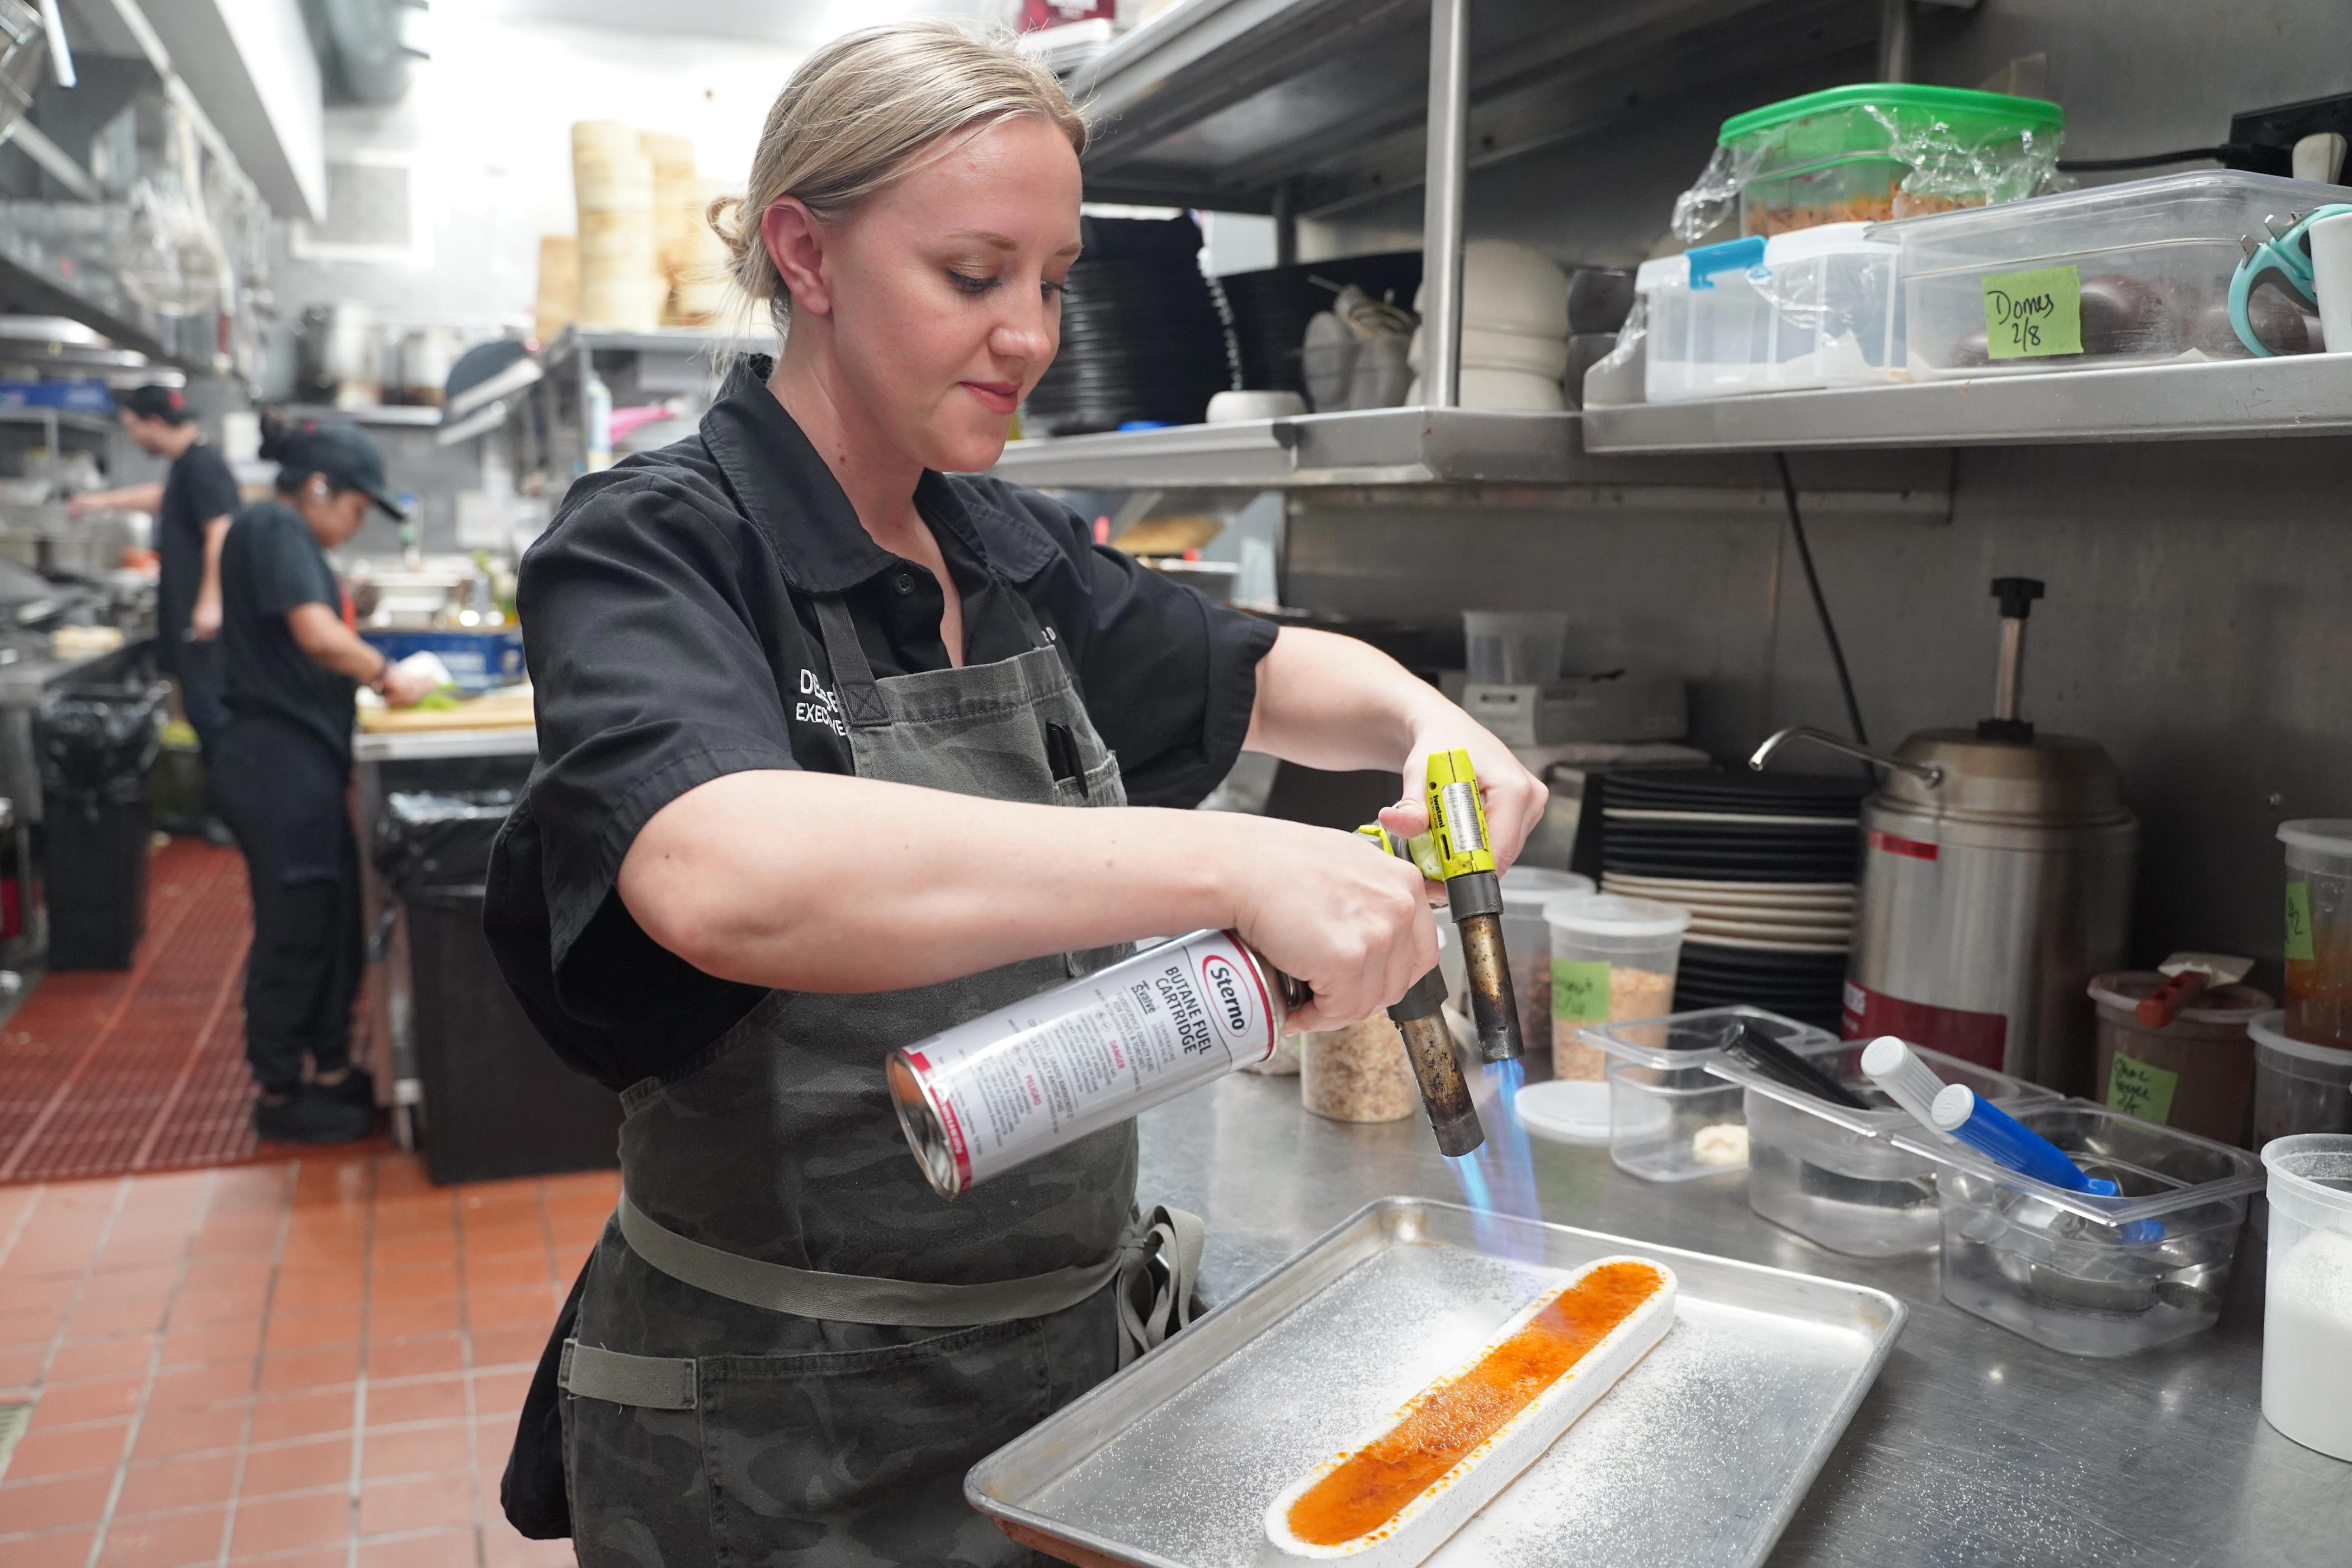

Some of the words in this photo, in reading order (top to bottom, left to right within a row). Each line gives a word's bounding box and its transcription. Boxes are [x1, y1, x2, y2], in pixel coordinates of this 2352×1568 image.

[1986, 290, 2054, 325] Domes
[2012, 317, 2041, 352] 2/8
[1433, 794, 1446, 828] Iwatani
[1154, 976, 1197, 1054] CARTRIDGE
[1165, 966, 1201, 1019] BUTANE
[1192, 1019, 1213, 1055] FUEL
[1210, 967, 1245, 1031] Sterno
[1107, 1039, 1126, 1070] DANGER
[1024, 1074, 1042, 1106] PELIGRO
